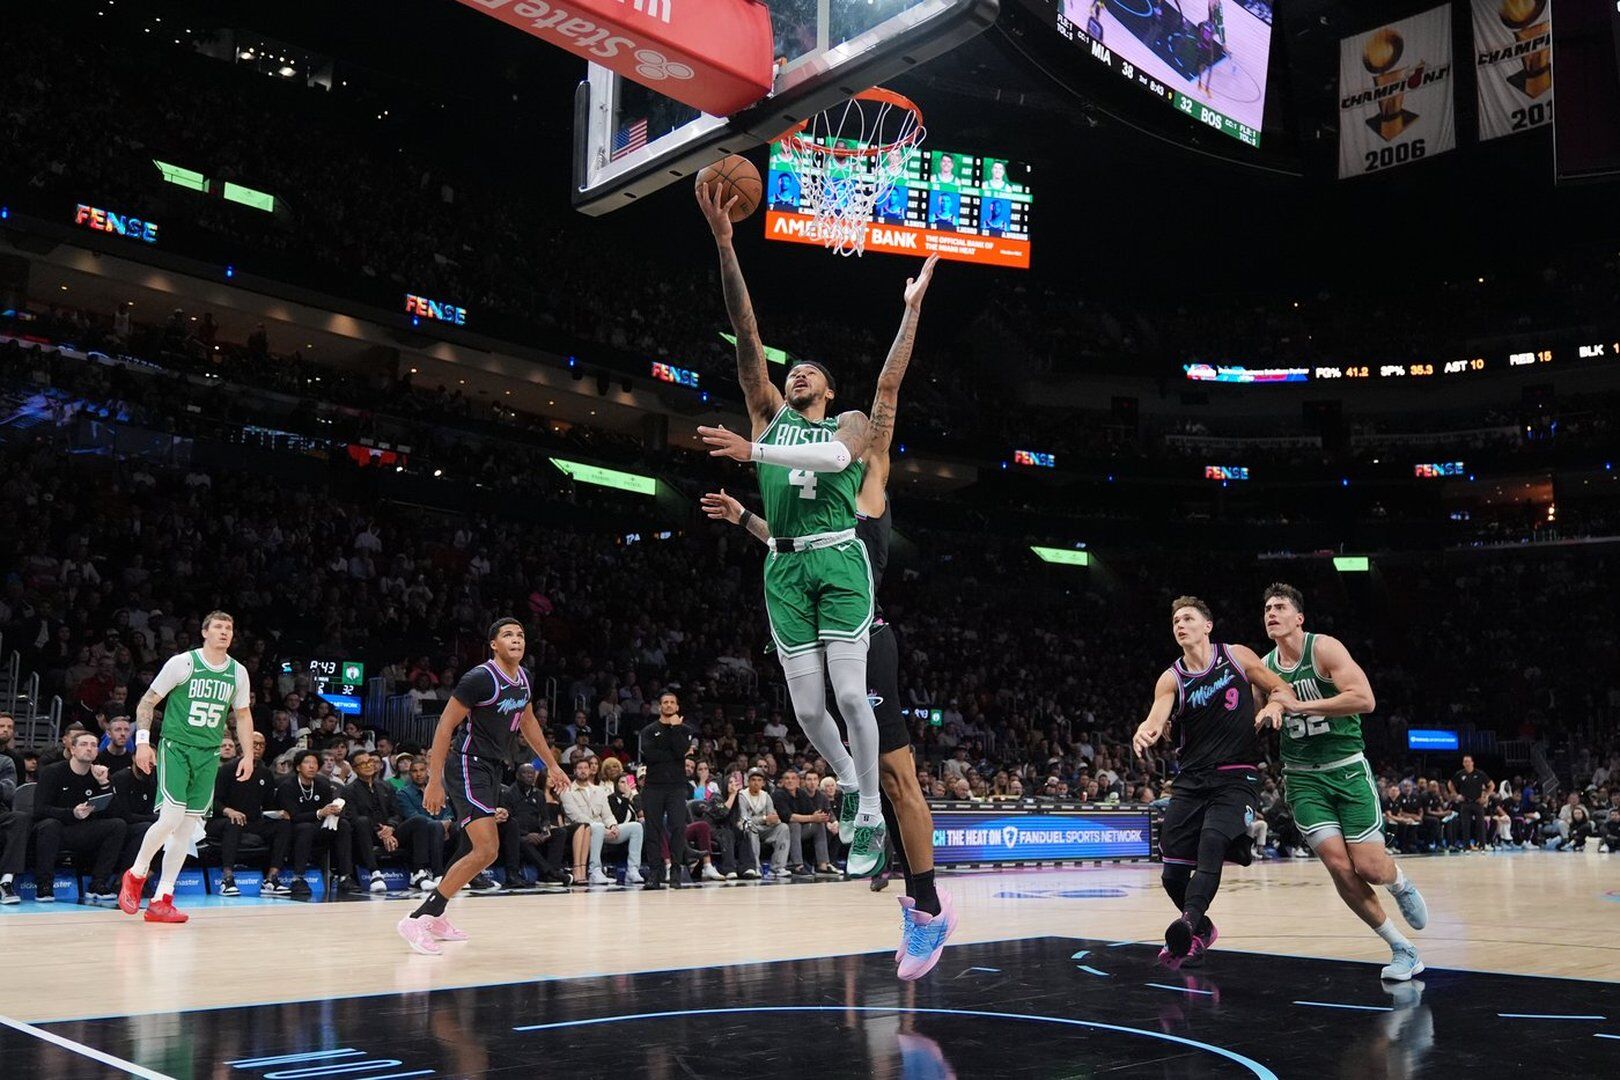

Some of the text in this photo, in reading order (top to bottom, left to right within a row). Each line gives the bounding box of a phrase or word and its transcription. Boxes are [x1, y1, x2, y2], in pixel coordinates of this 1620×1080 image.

[513, 1, 636, 58] State
[1478, 34, 1551, 65] CHAMPI
[1092, 40, 1111, 66] MIA
[1122, 62, 1134, 79] 38
[1180, 96, 1192, 113] 32
[1201, 107, 1222, 130] BOS
[1512, 100, 1553, 130] 201
[1364, 139, 1426, 172] 2006
[76, 204, 158, 243] FENSE
[774, 218, 918, 249] AMET BANK
[406, 293, 467, 326] FENSE
[652, 361, 700, 388] FENSE
[1346, 367, 1369, 378] 41.2
[1444, 360, 1468, 374] AST
[1470, 358, 1485, 370] 10
[1538, 350, 1552, 362] 15
[1579, 344, 1604, 358] BLK
[775, 424, 832, 446] BOSTO
[1014, 449, 1464, 481] FENSE FENSE FENSE
[788, 469, 818, 500] 4
[188, 678, 234, 703] BOSTON
[497, 693, 529, 715] Miami
[1187, 669, 1236, 709] Miami
[1224, 688, 1239, 711] 9
[1293, 678, 1323, 702] TON
[188, 702, 225, 728] 55
[948, 830, 965, 846] THE
[966, 830, 988, 845] HEAT
[989, 830, 1001, 845] ON
[1020, 830, 1064, 844] FANDUEL
[1066, 830, 1100, 843] SPORTS
[1100, 830, 1142, 843] NETWORK
